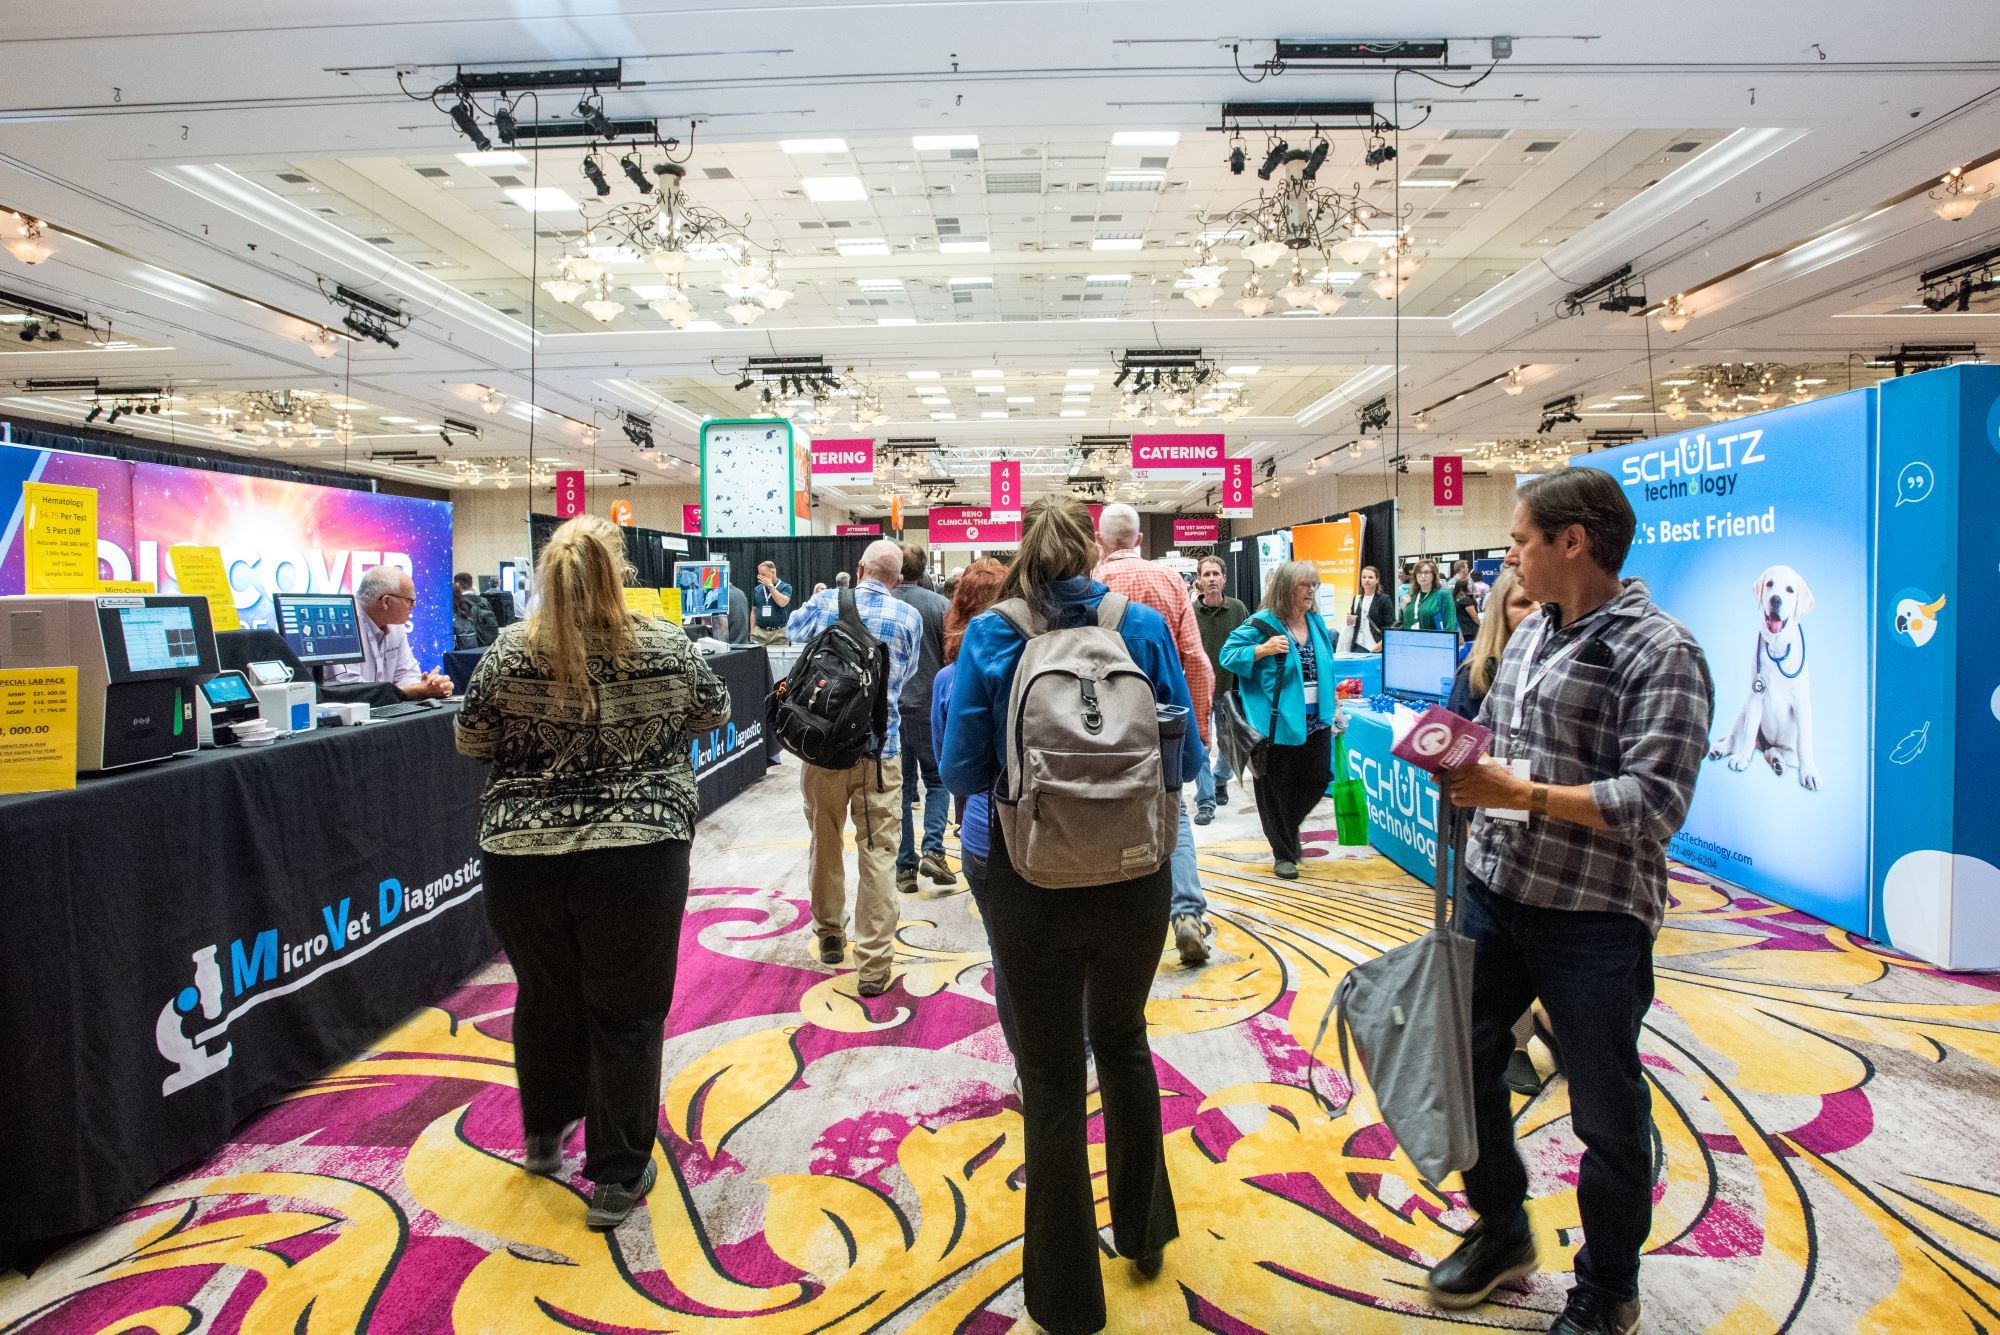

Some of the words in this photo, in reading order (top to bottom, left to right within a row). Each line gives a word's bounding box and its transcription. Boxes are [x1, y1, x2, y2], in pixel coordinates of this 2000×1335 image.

[811, 451, 867, 465] TERING
[1139, 446, 1218, 459] CATERING
[1622, 429, 1765, 486] SCHULTZ
[566, 477, 575, 514] 200
[1001, 468, 1010, 505] 400
[1233, 464, 1242, 502] 500
[1444, 462, 1452, 500] 600
[1645, 472, 1738, 502] technology
[42, 496, 84, 508] Hematology
[74, 513, 88, 521] Test
[961, 510, 983, 518] RENO
[46, 526, 51, 534] 5
[53, 527, 67, 535] Part
[68, 527, 81, 535] Diff
[1660, 518, 1700, 543] Best
[1706, 505, 1775, 540] Friend
[98, 539, 412, 610] DICOVE
[10, 725, 49, 735] 000.00
[1366, 795, 1438, 868] technolog
[230, 896, 371, 997] MicroVet
[379, 857, 481, 928] Diagnostic
